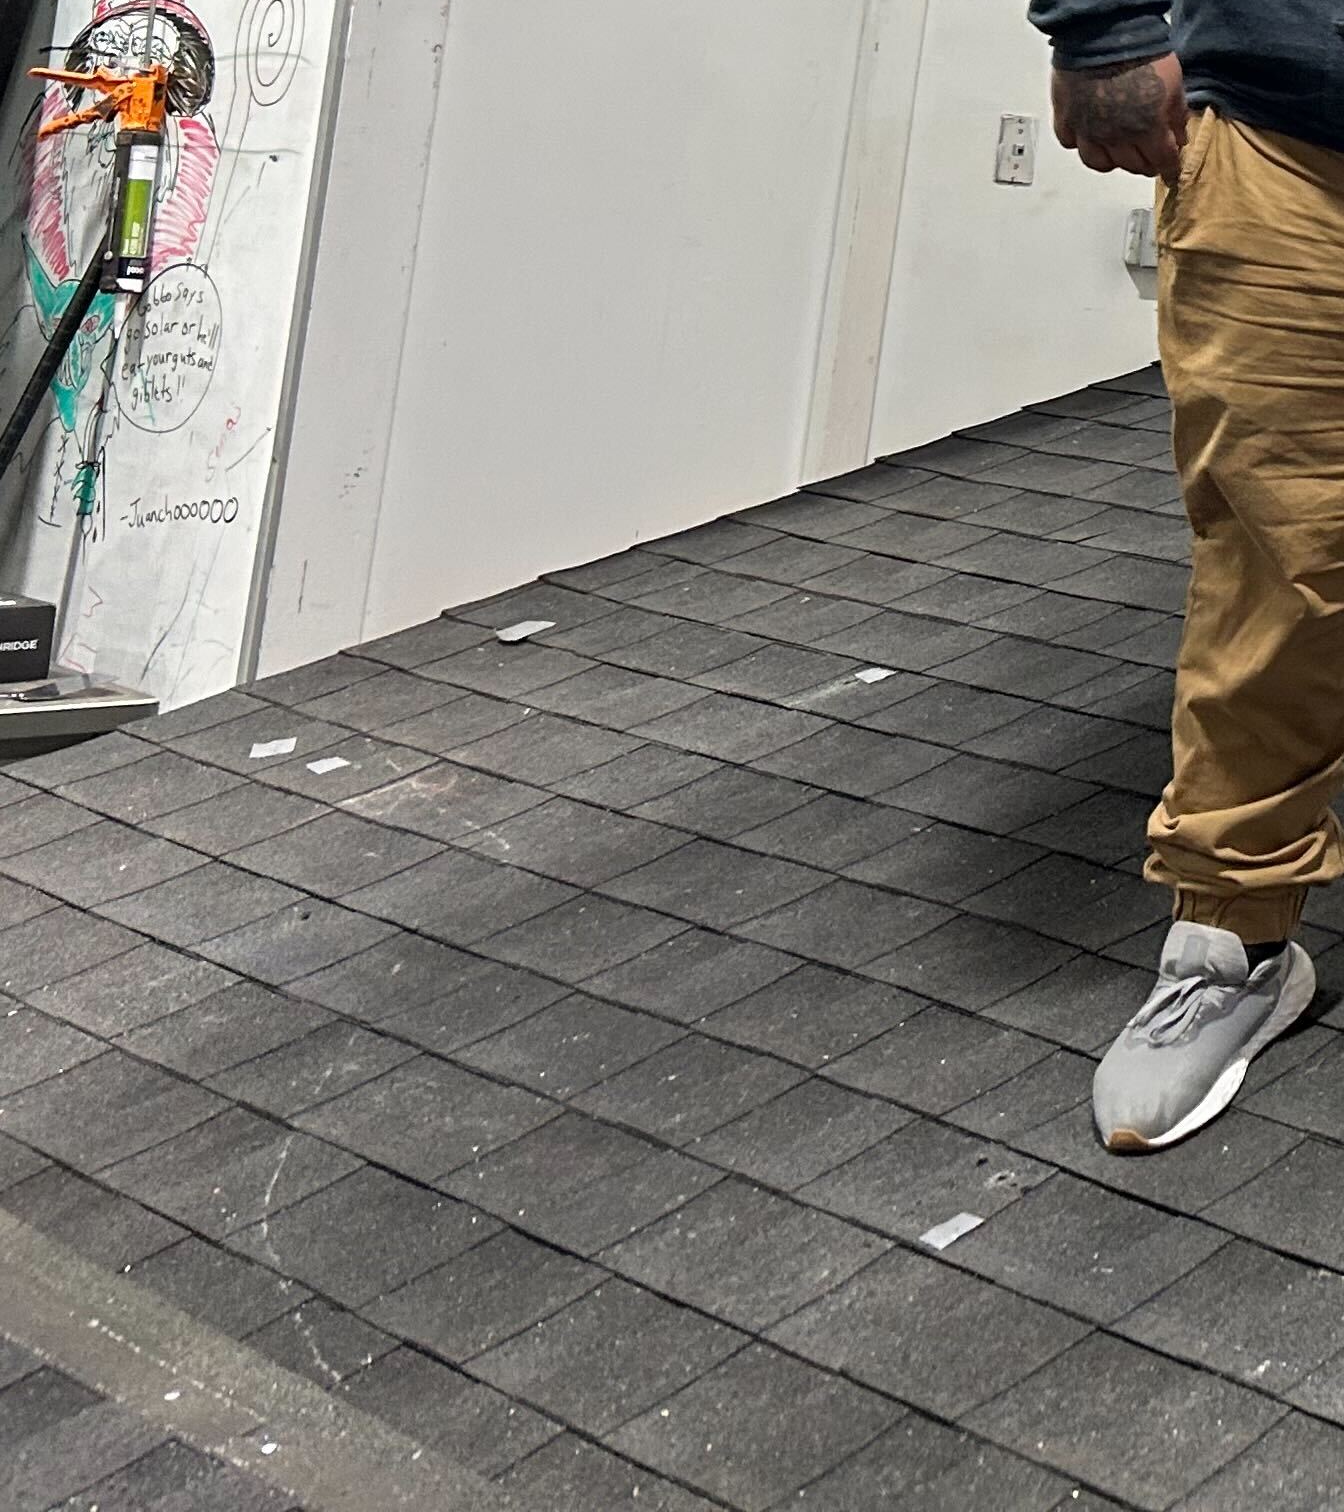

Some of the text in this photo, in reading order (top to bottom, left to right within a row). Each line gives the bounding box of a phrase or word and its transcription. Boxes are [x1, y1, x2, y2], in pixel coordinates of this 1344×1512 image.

[124, 329, 140, 355] go
[182, 324, 196, 335] or
[197, 356, 214, 372] and
